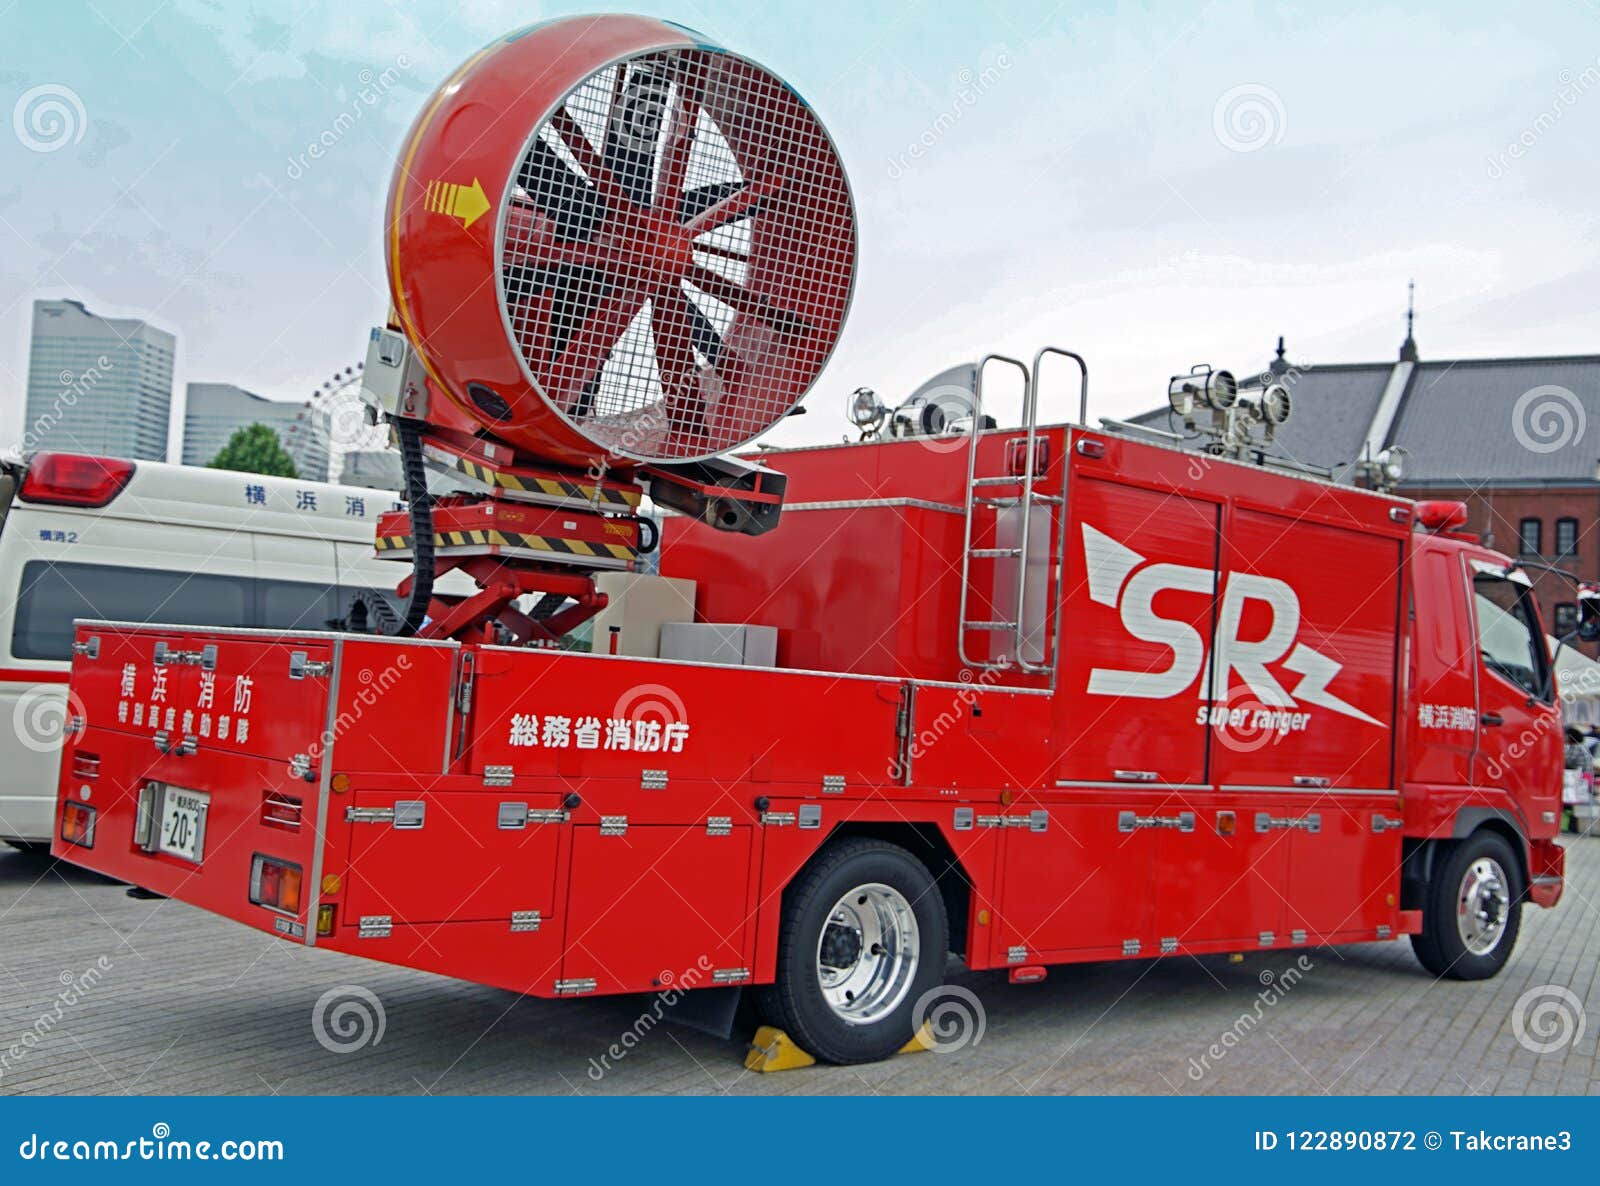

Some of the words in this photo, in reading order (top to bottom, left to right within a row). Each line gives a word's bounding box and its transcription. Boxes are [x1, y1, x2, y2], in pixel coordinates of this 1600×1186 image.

[244, 484, 409, 518] 横浜消
[1086, 562, 1299, 709] SR
[120, 662, 254, 714] 横浜消防
[508, 712, 691, 753] 総務省消防庁
[1196, 705, 1250, 733] super
[1250, 708, 1312, 736] ranger
[1417, 703, 1478, 732] 横浜消防
